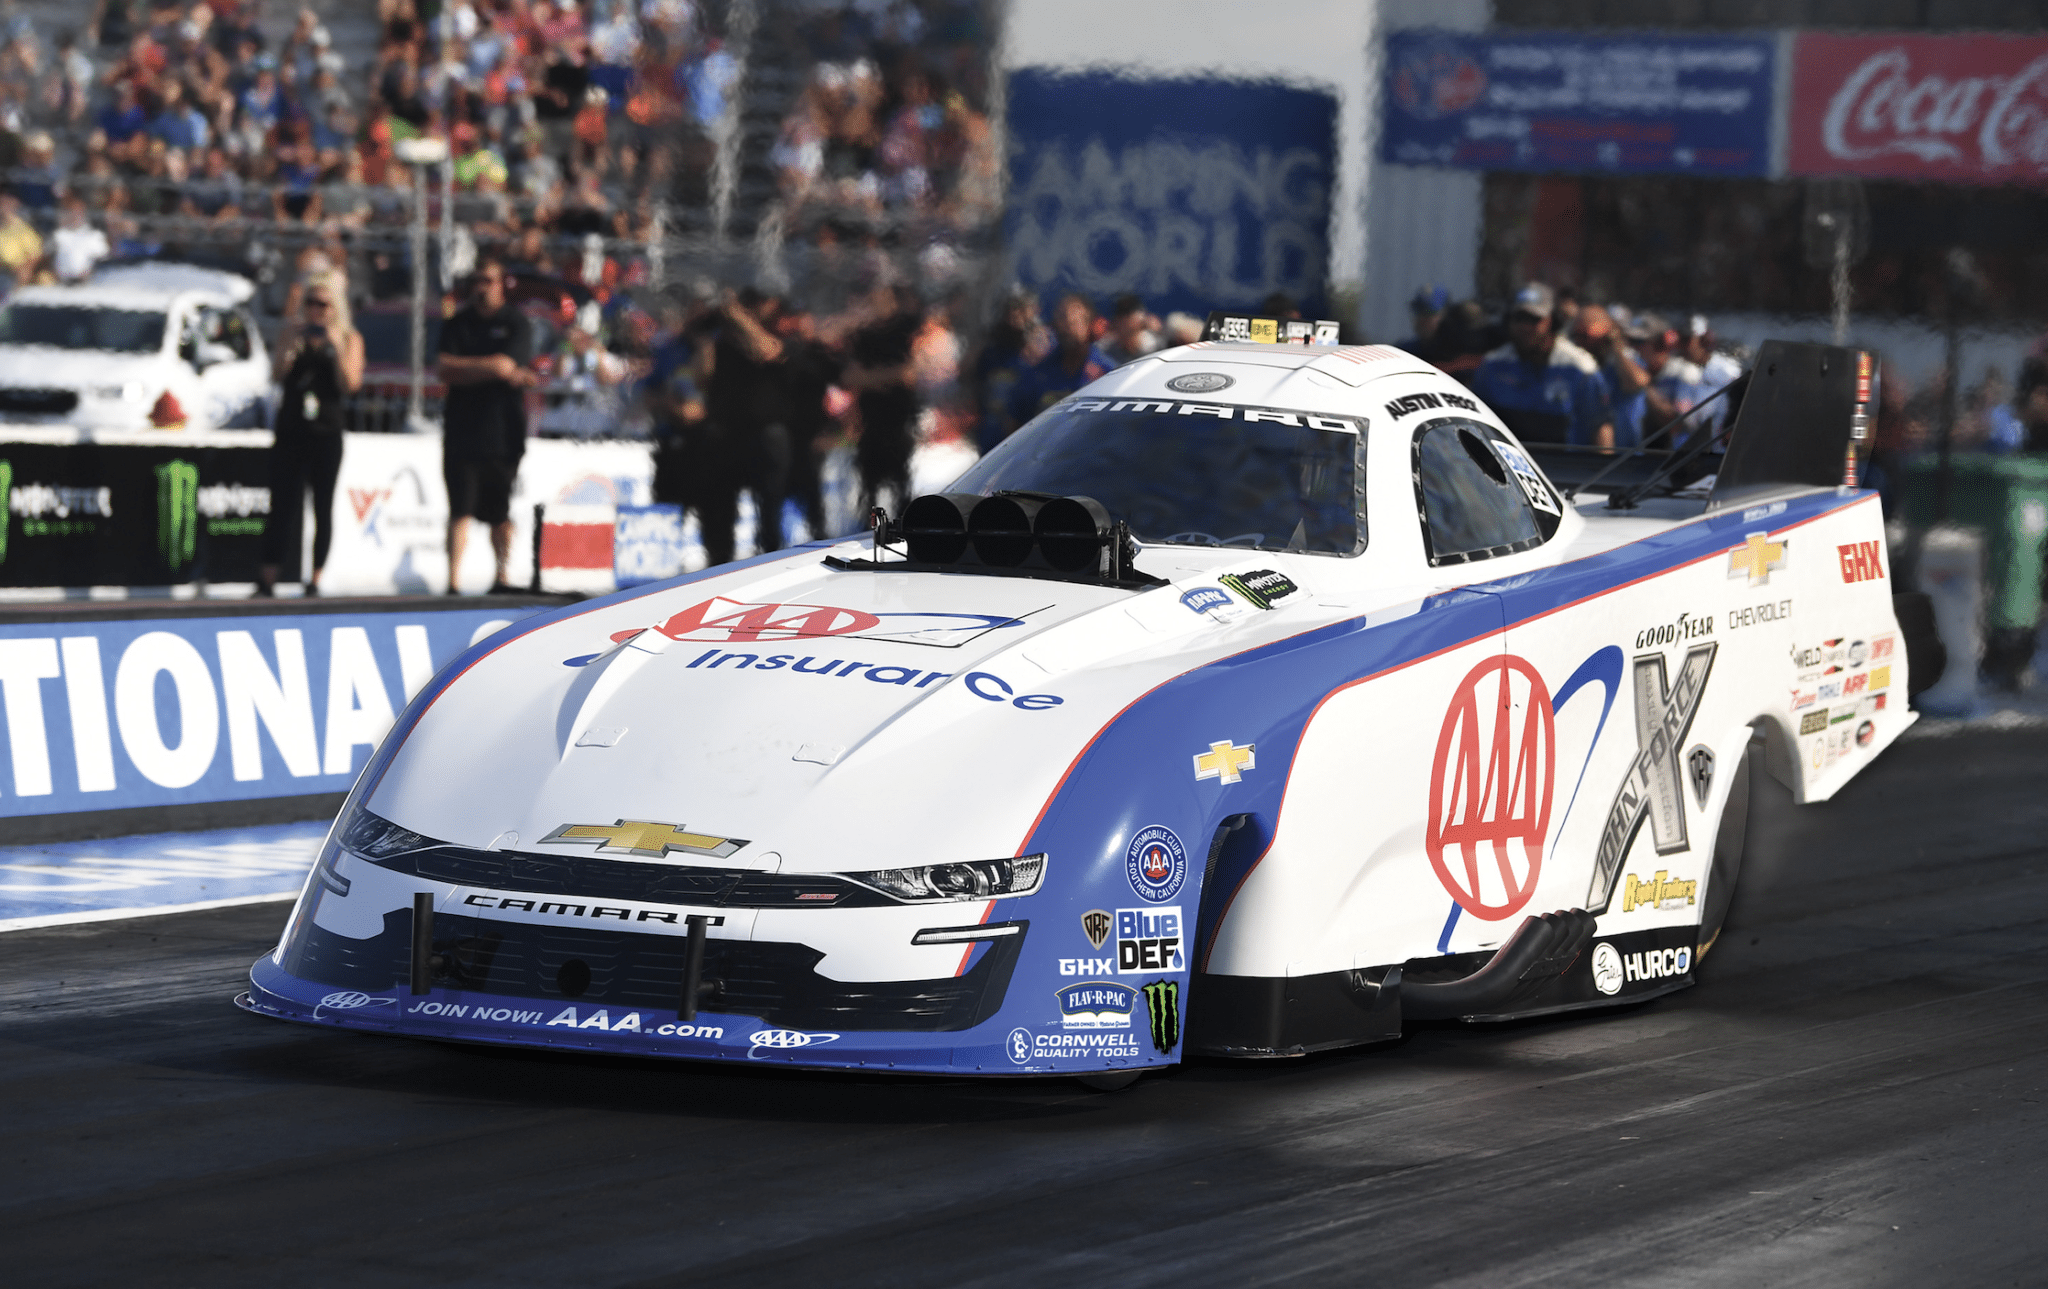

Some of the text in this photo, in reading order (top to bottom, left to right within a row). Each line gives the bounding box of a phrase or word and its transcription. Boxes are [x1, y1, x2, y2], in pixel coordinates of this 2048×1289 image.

[1047, 400, 1361, 435] CAMARO
[1384, 391, 1444, 422] AUSTIN
[1836, 540, 1885, 584] GHX
[1729, 599, 1793, 630] CHEVROLET
[686, 648, 1065, 710] Insurance
[1427, 655, 1555, 921] AAA
[1599, 787, 1641, 894] JOHN
[1637, 665, 1698, 790] FORCE
[1130, 829, 1182, 858] AUTOMOBILE CLUB
[1143, 853, 1170, 872] AAA
[1129, 860, 1185, 899] SOUTHERN CALIFORNIA
[1117, 911, 1179, 939] Blue
[1058, 958, 1114, 976] GHX
[1118, 938, 1180, 970] DEF
[1624, 945, 1692, 983] HURCO
[407, 1001, 724, 1039] JOIN NOW! AAA.com
[750, 1029, 811, 1049] AAA
[1033, 1047, 1139, 1058] QUALITY TOOLS
[1036, 1034, 1136, 1047] CORNWELL
